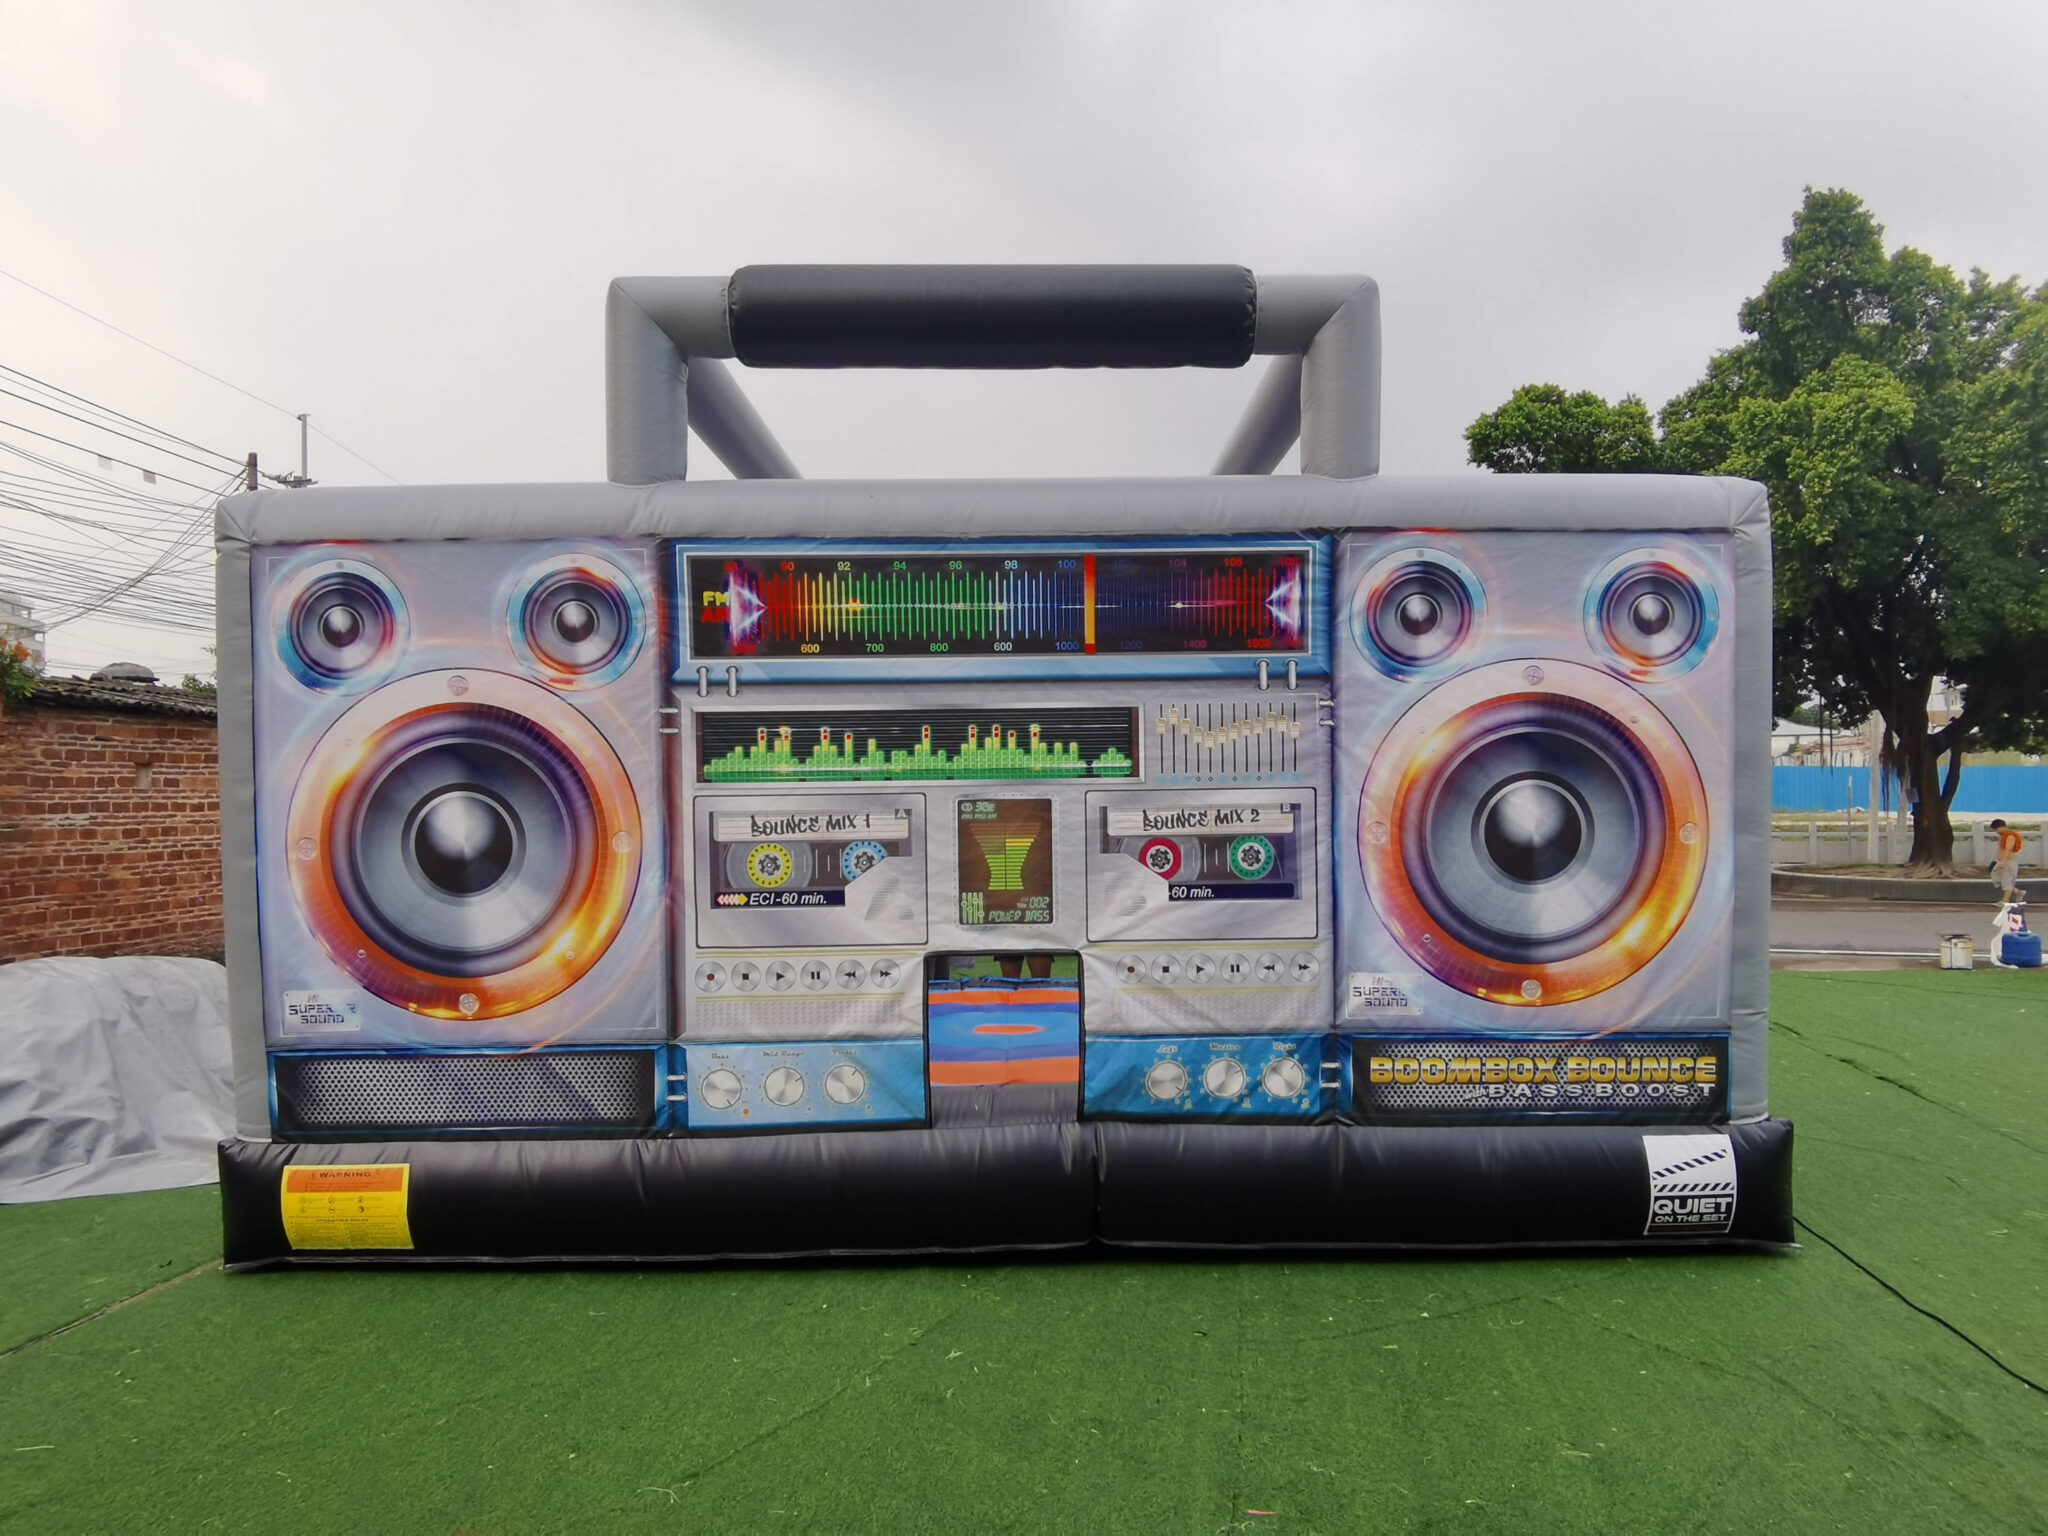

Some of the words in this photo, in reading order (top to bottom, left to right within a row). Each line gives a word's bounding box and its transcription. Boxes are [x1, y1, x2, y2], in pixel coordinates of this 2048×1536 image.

[837, 561, 851, 571] 92
[893, 561, 907, 571] 94
[949, 561, 963, 571] 96
[1004, 560, 1018, 570] 98
[1058, 560, 1077, 569] 100
[1169, 558, 1187, 567] 104
[800, 644, 820, 653] 600
[866, 643, 884, 653] 700
[930, 643, 949, 652] 800
[1055, 641, 1079, 651] 1000
[1183, 640, 1207, 649] 1400
[750, 814, 821, 837] BOUNCE
[826, 814, 857, 831] MIX
[862, 813, 870, 828] 1
[1142, 808, 1209, 832] BOUNCE
[1214, 808, 1244, 827] MIX
[1250, 808, 1260, 823] 2
[1190, 885, 1215, 898] min.
[800, 892, 827, 905] min.
[1364, 998, 1408, 1007] SOUND
[301, 1014, 345, 1024] SOUND
[1370, 1056, 1558, 1084] BOOMBOX
[1567, 1056, 1716, 1083] BOUNCE
[1488, 1084, 1587, 1098] BASS
[1595, 1083, 1716, 1097] BOOST
[1654, 1198, 1732, 1214] QUIET
[1677, 1214, 1700, 1222] THE
[1702, 1214, 1727, 1222] SET
